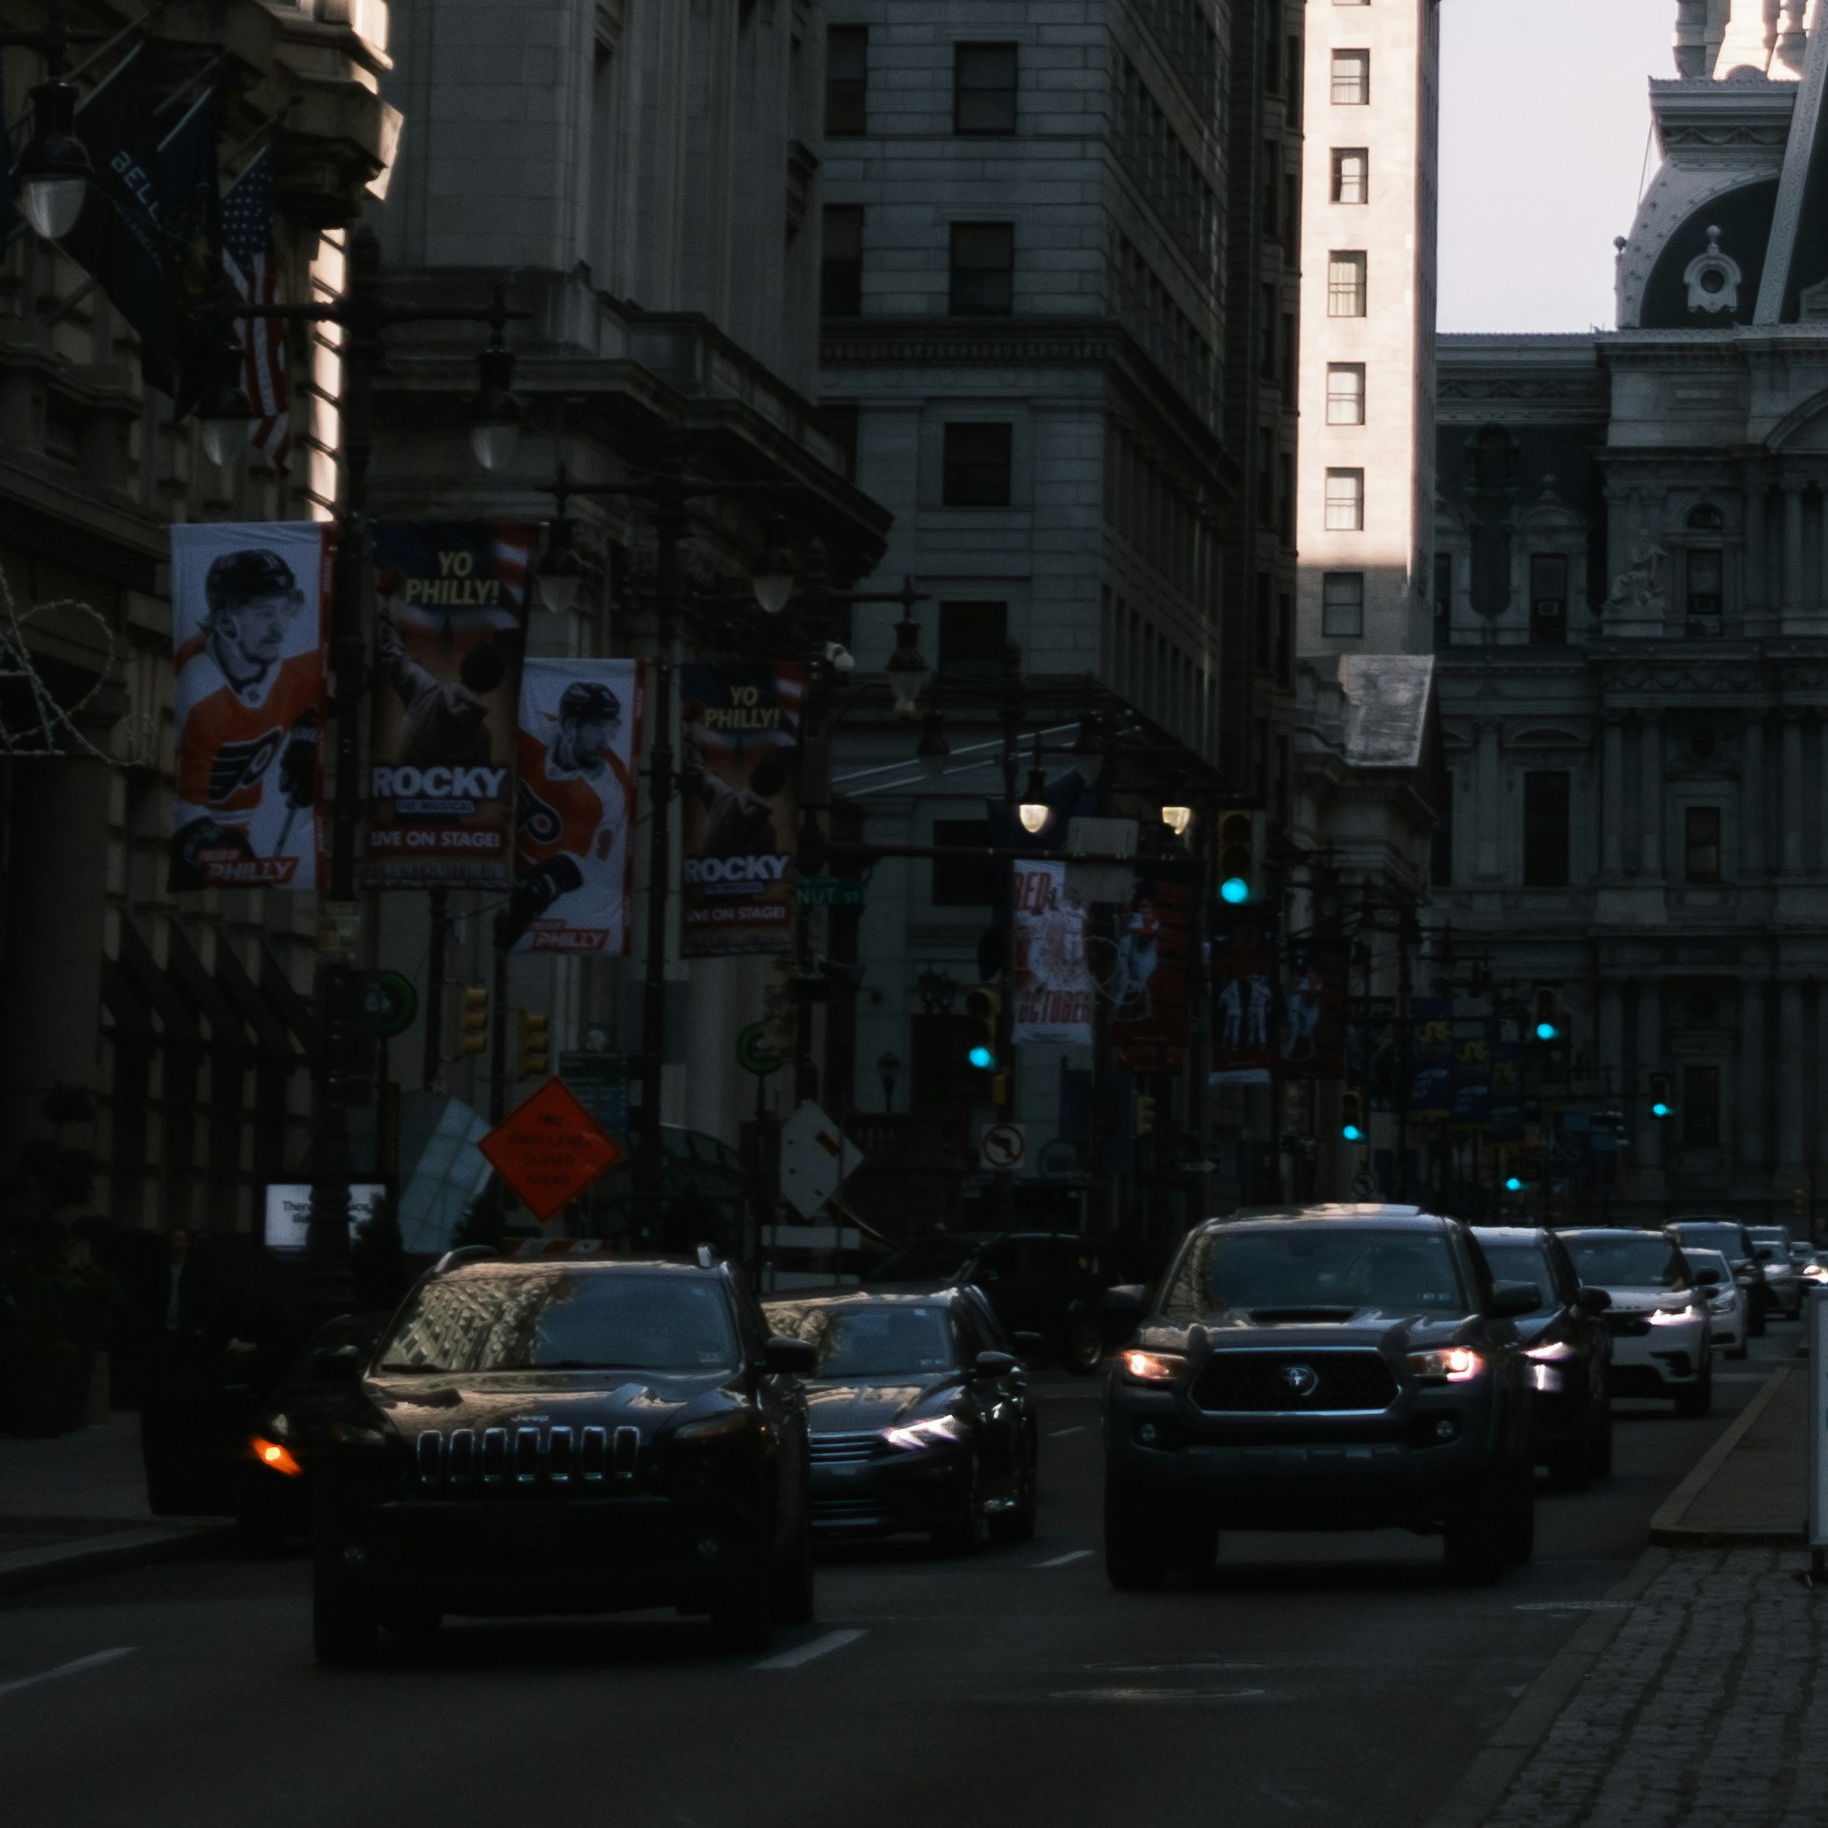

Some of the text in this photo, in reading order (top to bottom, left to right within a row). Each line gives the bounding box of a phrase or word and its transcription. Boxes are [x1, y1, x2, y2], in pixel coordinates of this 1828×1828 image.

[437, 551, 473, 577] YO
[406, 578, 500, 605] PHILLY!
[729, 685, 759, 707] YO
[704, 707, 780, 730] PHILLY!
[373, 765, 508, 799] ROCKY
[371, 830, 501, 848] LIVE ON STAGE!
[208, 861, 294, 881] PHILLY
[684, 854, 791, 883] ROCKY
[711, 908, 735, 921] ON
[738, 906, 786, 920] STAGE!
